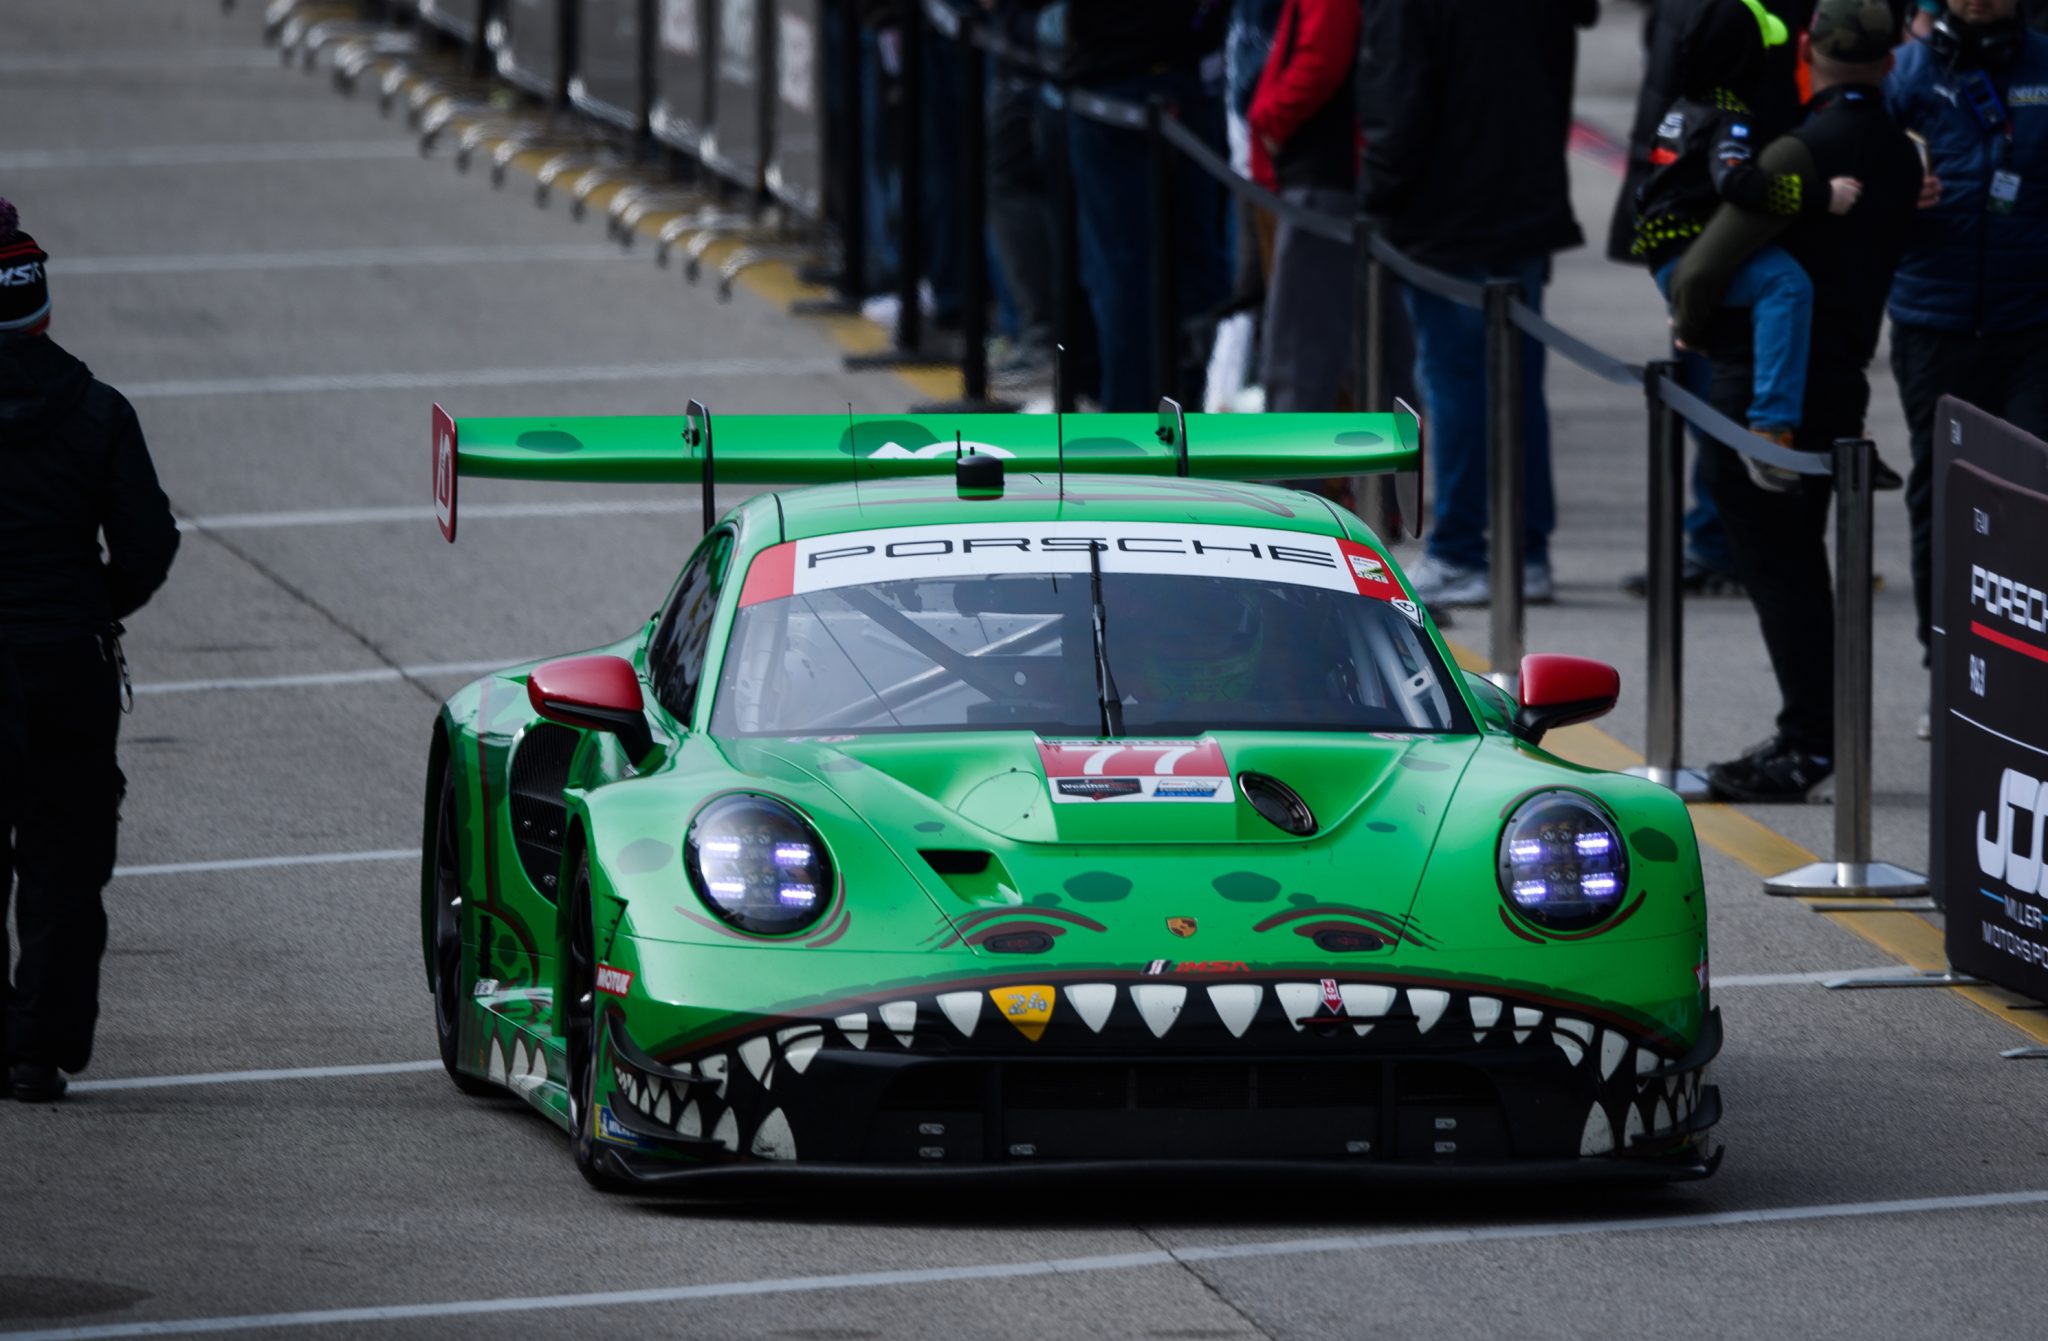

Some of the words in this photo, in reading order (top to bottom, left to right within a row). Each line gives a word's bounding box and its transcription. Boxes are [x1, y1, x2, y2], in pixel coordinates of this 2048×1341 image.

[808, 536, 1338, 571] PORSCHE
[1060, 745, 1197, 775] 77
[2003, 894, 2044, 931] MILLER
[596, 967, 630, 995] MOTUL
[1175, 960, 1250, 974] IMSA
